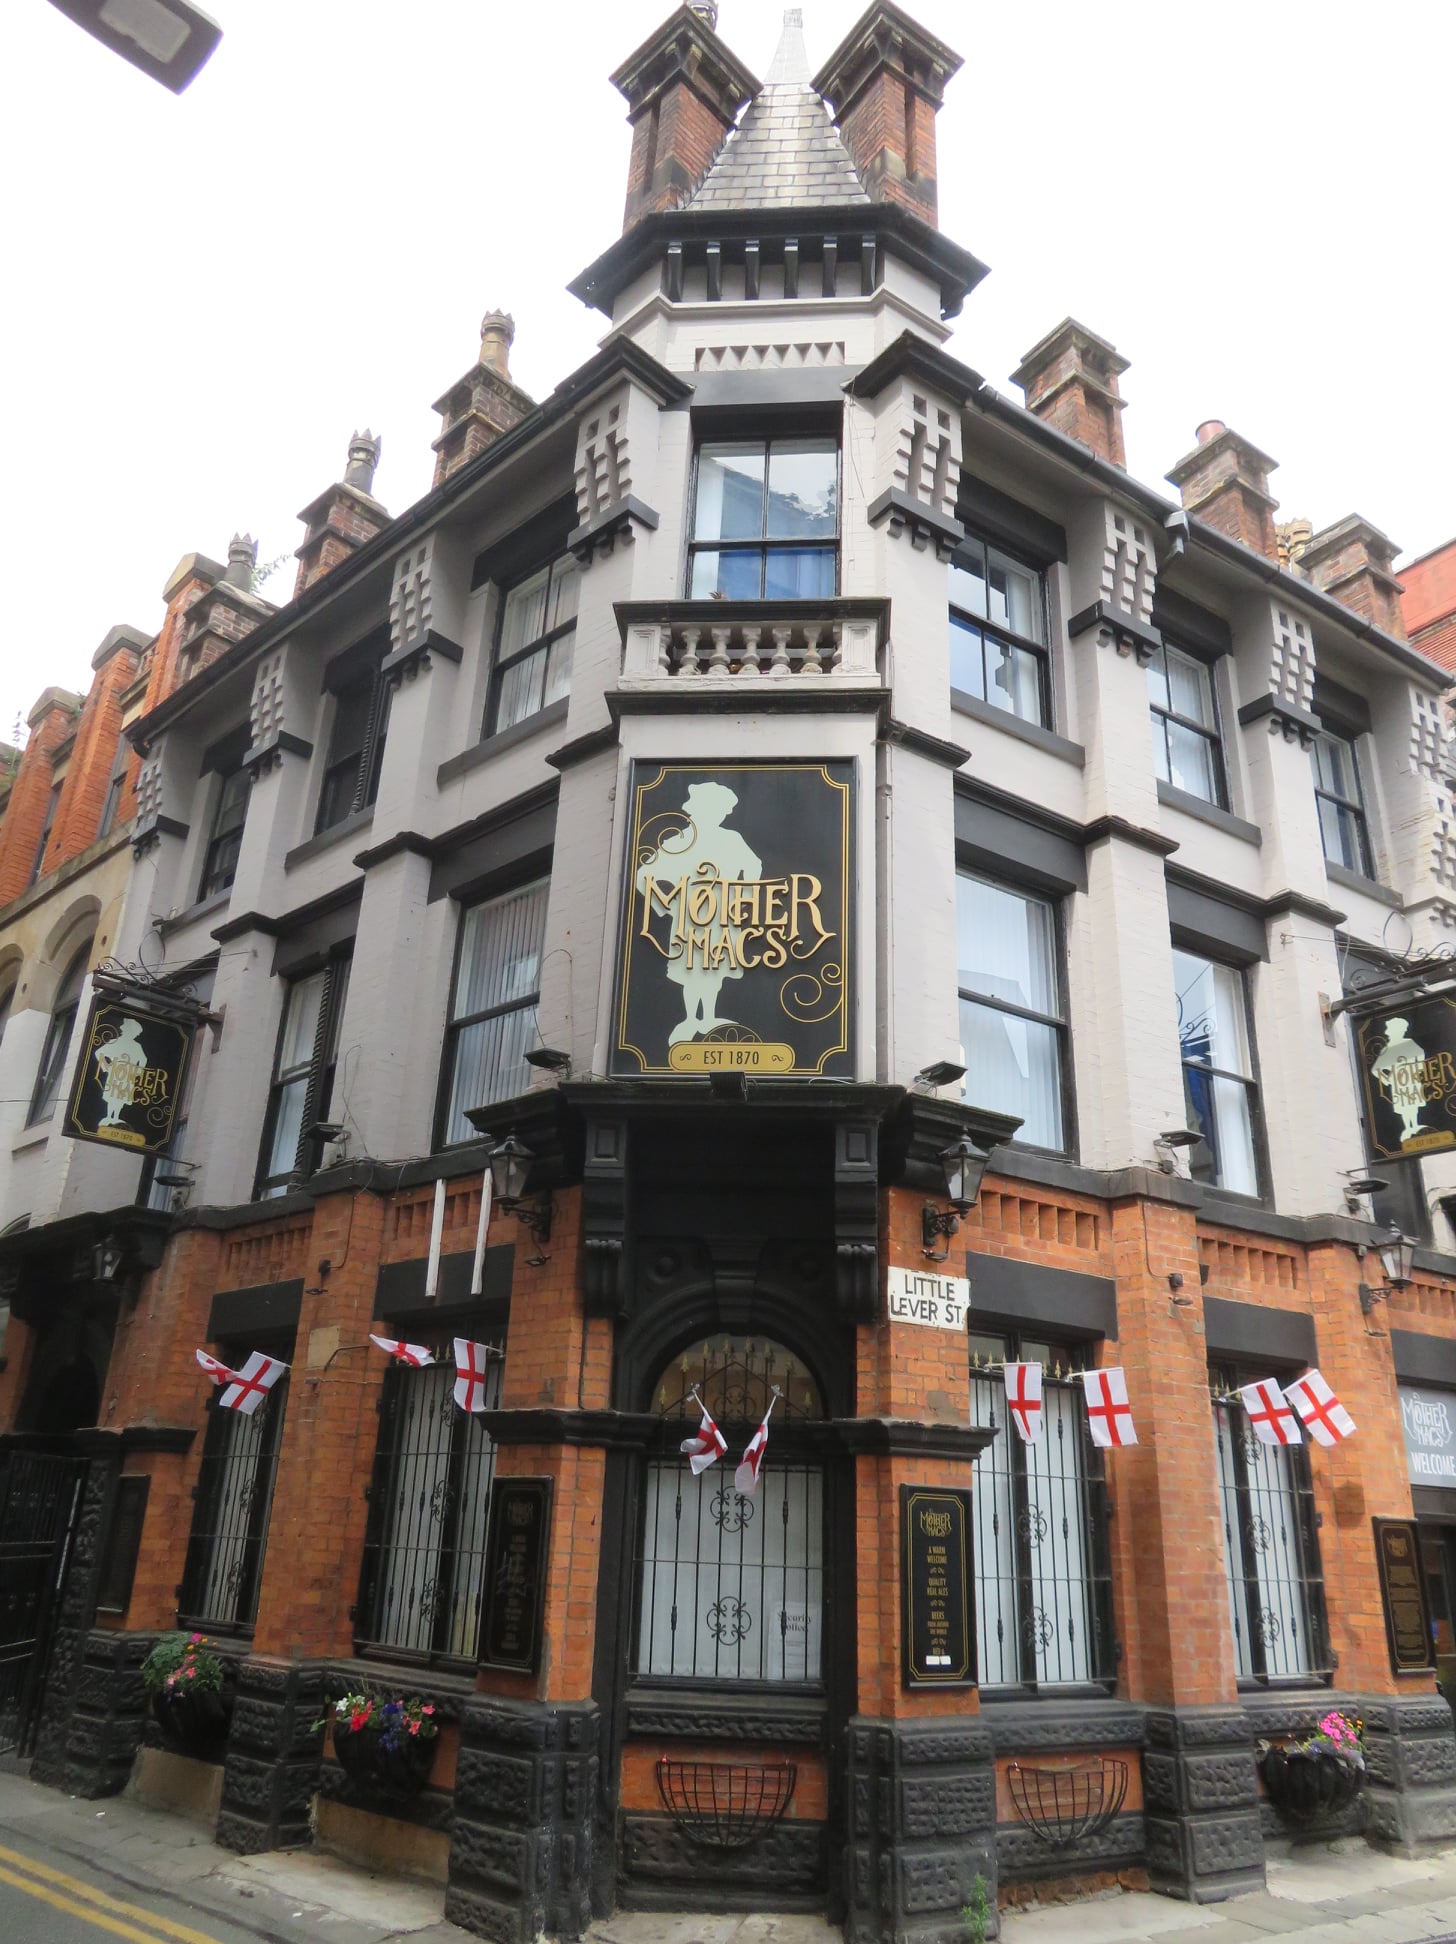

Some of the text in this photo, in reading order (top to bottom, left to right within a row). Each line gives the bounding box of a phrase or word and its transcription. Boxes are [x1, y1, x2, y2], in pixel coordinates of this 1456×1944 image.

[639, 861, 837, 959] MOTHER
[686, 927, 788, 970] MACS
[703, 1050, 760, 1065] EST 1870
[94, 1053, 169, 1104] MOTHER
[1376, 1052, 1456, 1105] MOTHER
[110, 1079, 151, 1106] MACS
[1400, 1080, 1444, 1107] MACS
[904, 1273, 955, 1302] LITTLE
[890, 1294, 938, 1322] LEVER
[1400, 1391, 1454, 1444] MOTHER
[1418, 1426, 1444, 1448] MACS
[1410, 1451, 1456, 1477] WELCOME
[920, 1508, 952, 1535] MOTHER
[777, 1611, 813, 1625] Scuriy
